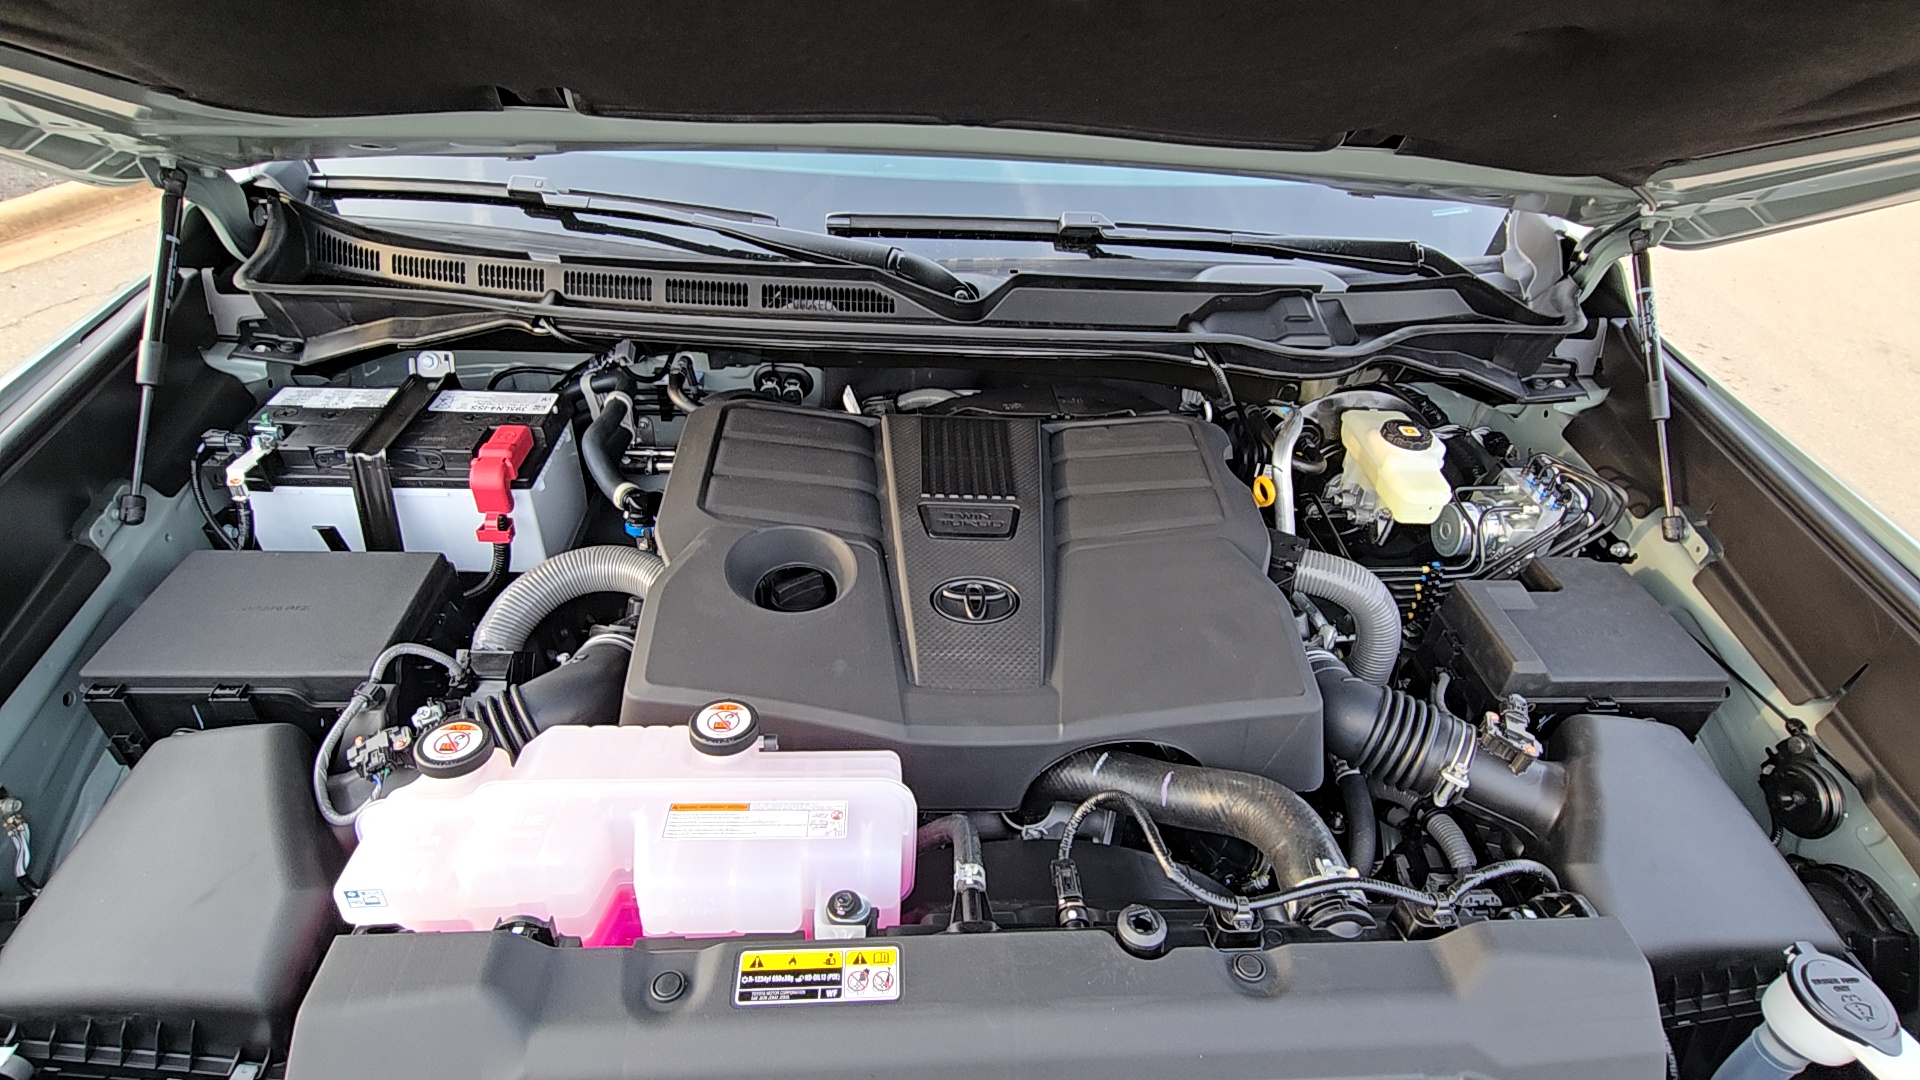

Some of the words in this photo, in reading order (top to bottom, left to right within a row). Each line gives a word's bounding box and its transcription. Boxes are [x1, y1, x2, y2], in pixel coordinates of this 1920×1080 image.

[944, 511, 992, 519] TWIN
[936, 518, 1005, 528] TURBO
[826, 989, 838, 997] WF
